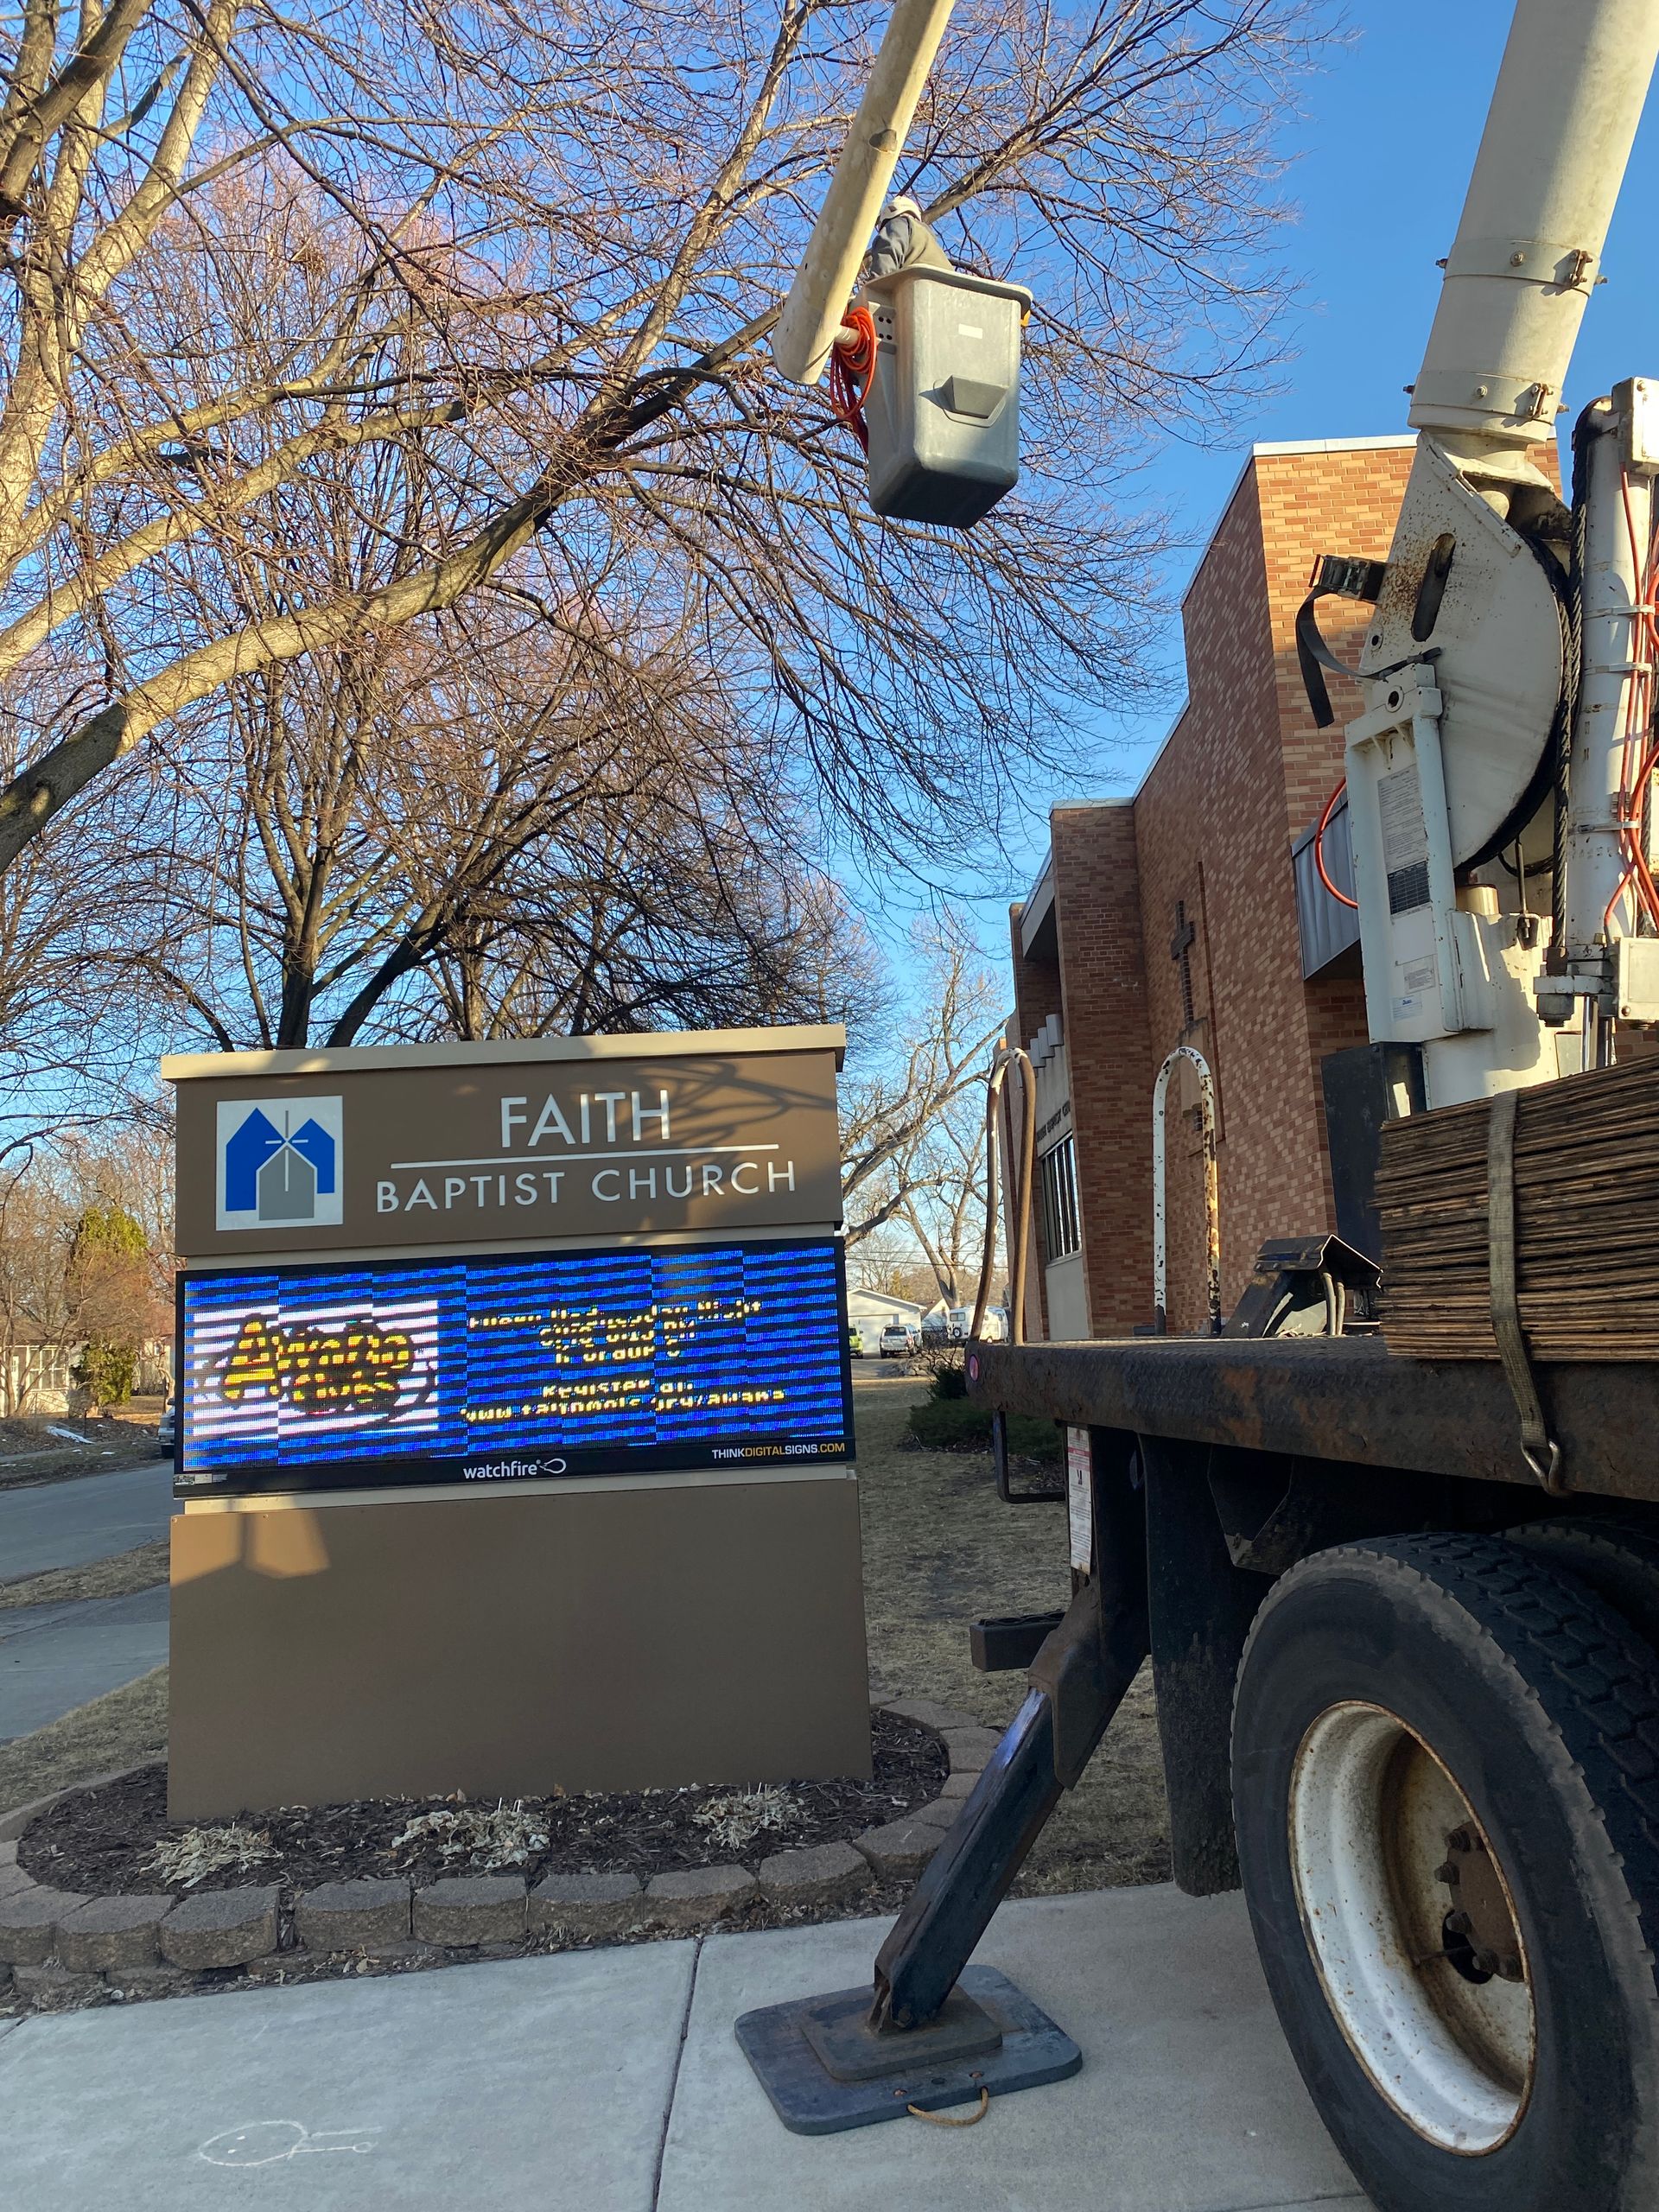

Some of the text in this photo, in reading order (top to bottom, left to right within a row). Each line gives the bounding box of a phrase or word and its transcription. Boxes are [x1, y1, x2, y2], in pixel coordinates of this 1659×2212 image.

[500, 1090, 671, 1147] FAITH
[375, 1160, 796, 1214] BAPTIST CHURCH
[711, 1442, 846, 1459] THINKDIGITALSIGNS.COM
[463, 1460, 537, 1478] watchfire
